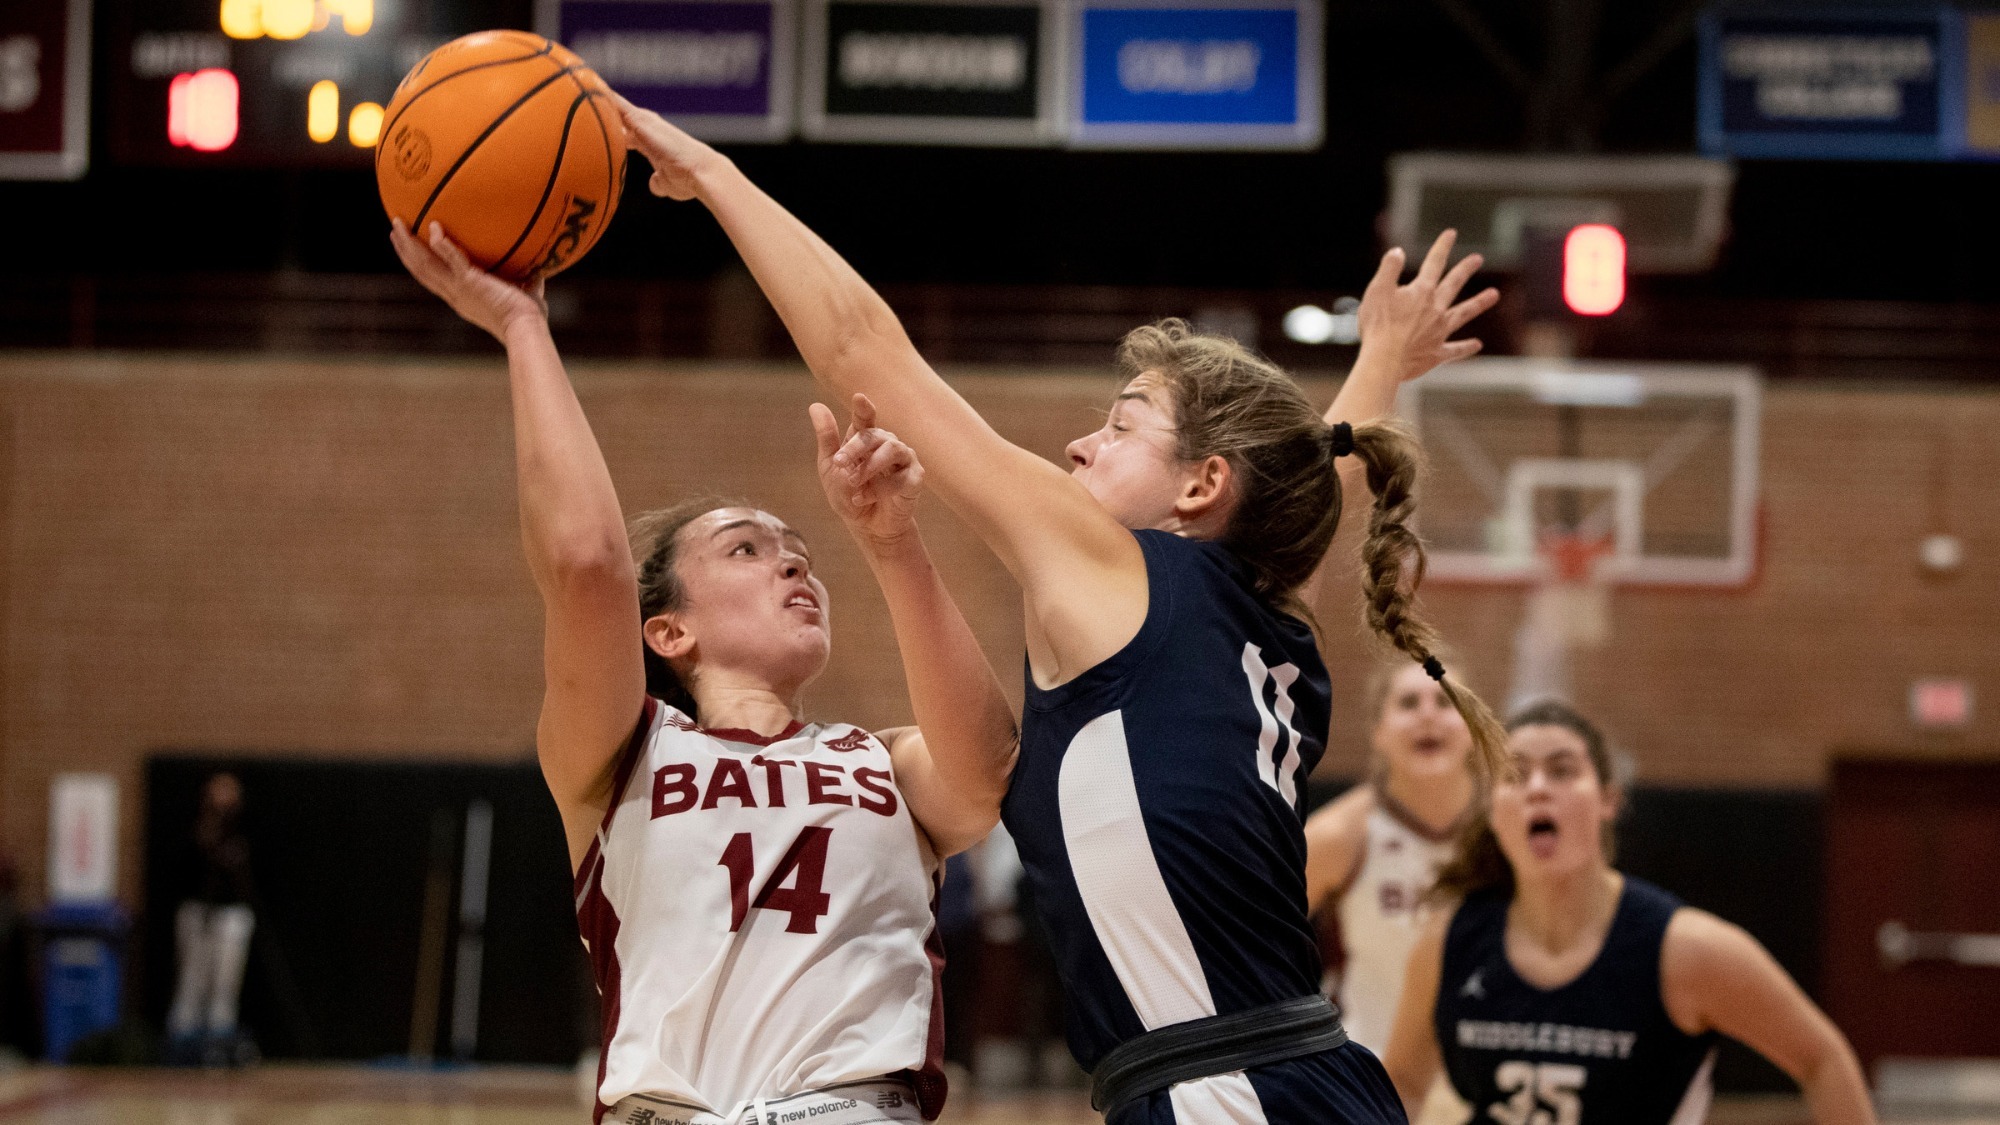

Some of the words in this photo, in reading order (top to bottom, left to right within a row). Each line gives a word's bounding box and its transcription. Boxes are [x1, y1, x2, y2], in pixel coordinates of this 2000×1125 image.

[1241, 641, 1301, 811] 11
[650, 756, 898, 821] BATES
[717, 825, 834, 934] 14
[1457, 1019, 1637, 1060] MIDDLEBURY
[781, 1111, 806, 1124] new
[809, 1098, 858, 1117] balance
[1487, 1060, 1588, 1125] 35
